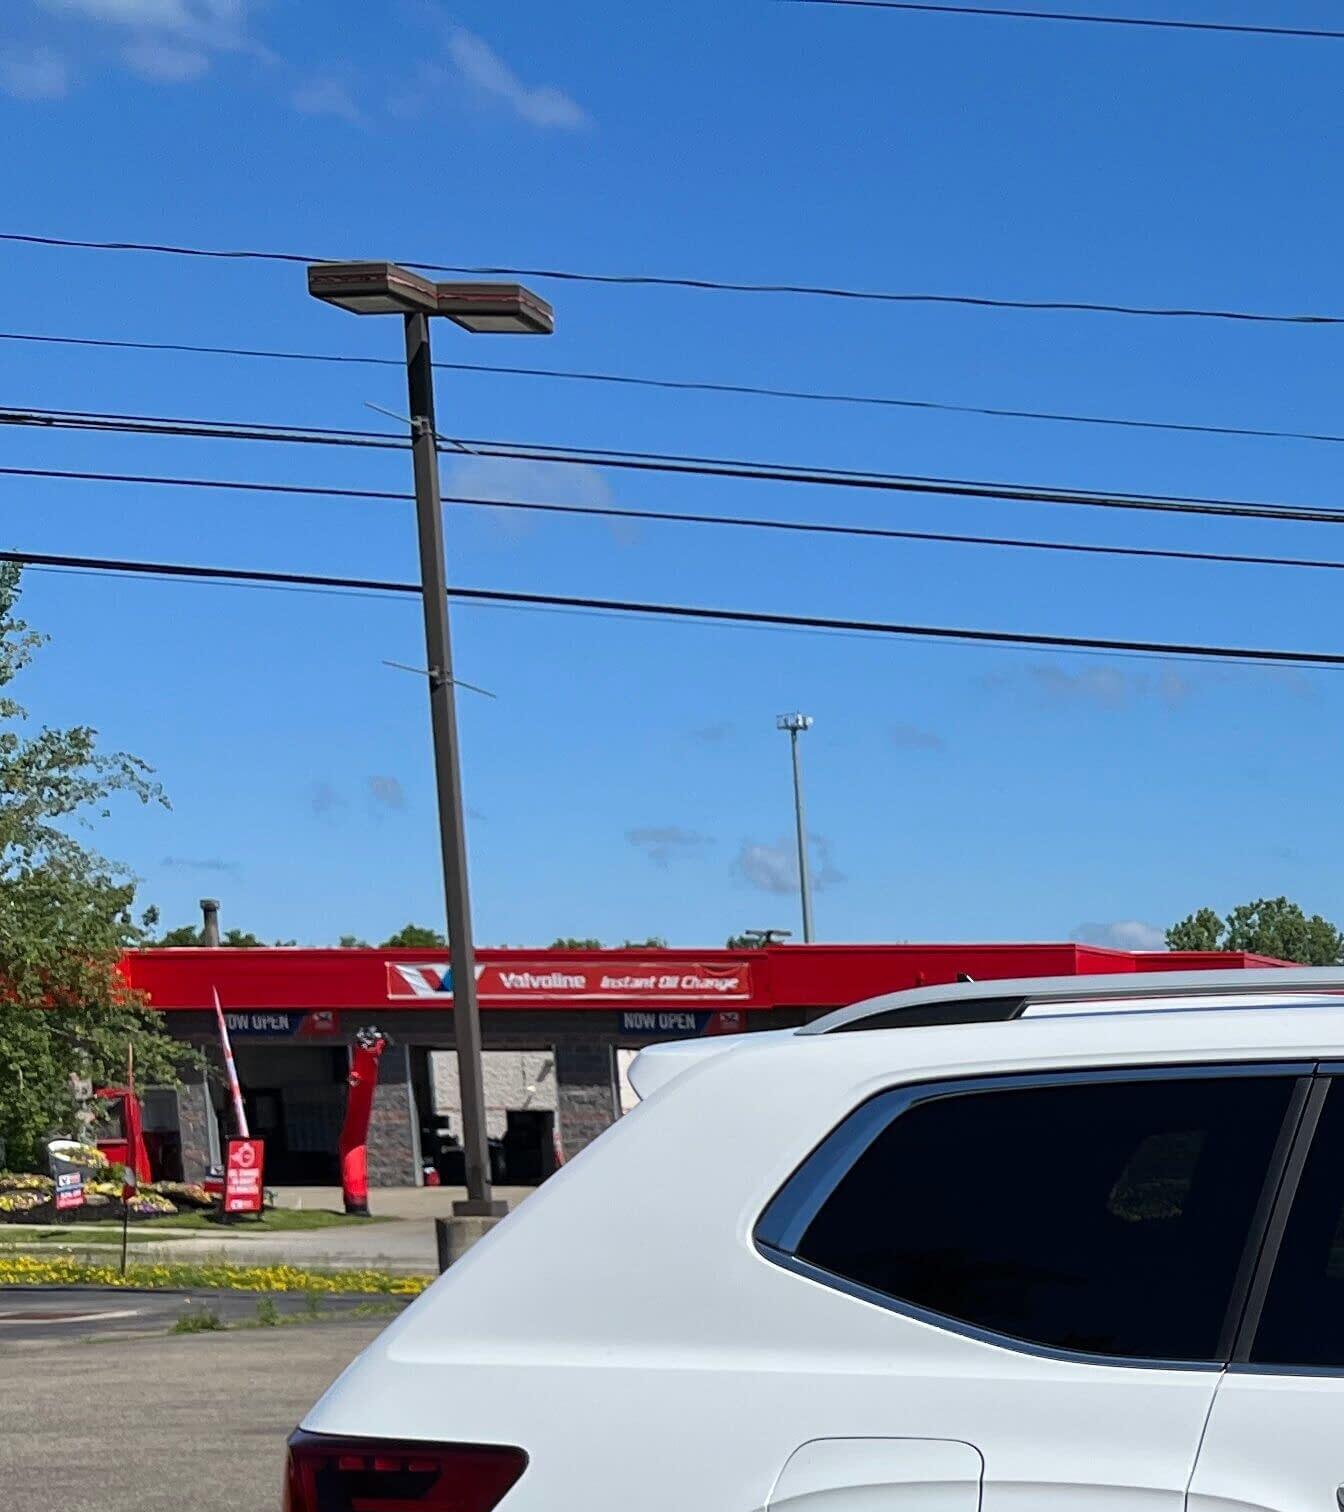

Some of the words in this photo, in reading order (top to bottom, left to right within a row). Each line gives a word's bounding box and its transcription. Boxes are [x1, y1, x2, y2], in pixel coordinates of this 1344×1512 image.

[498, 971, 587, 989] Valvoline
[600, 975, 656, 989] Instant
[658, 975, 680, 989] Oil
[680, 975, 740, 992] Change
[224, 1013, 249, 1030] OW
[252, 1013, 291, 1031] OPEN
[623, 1012, 656, 1030] NOW
[658, 1012, 697, 1030] OPEN
